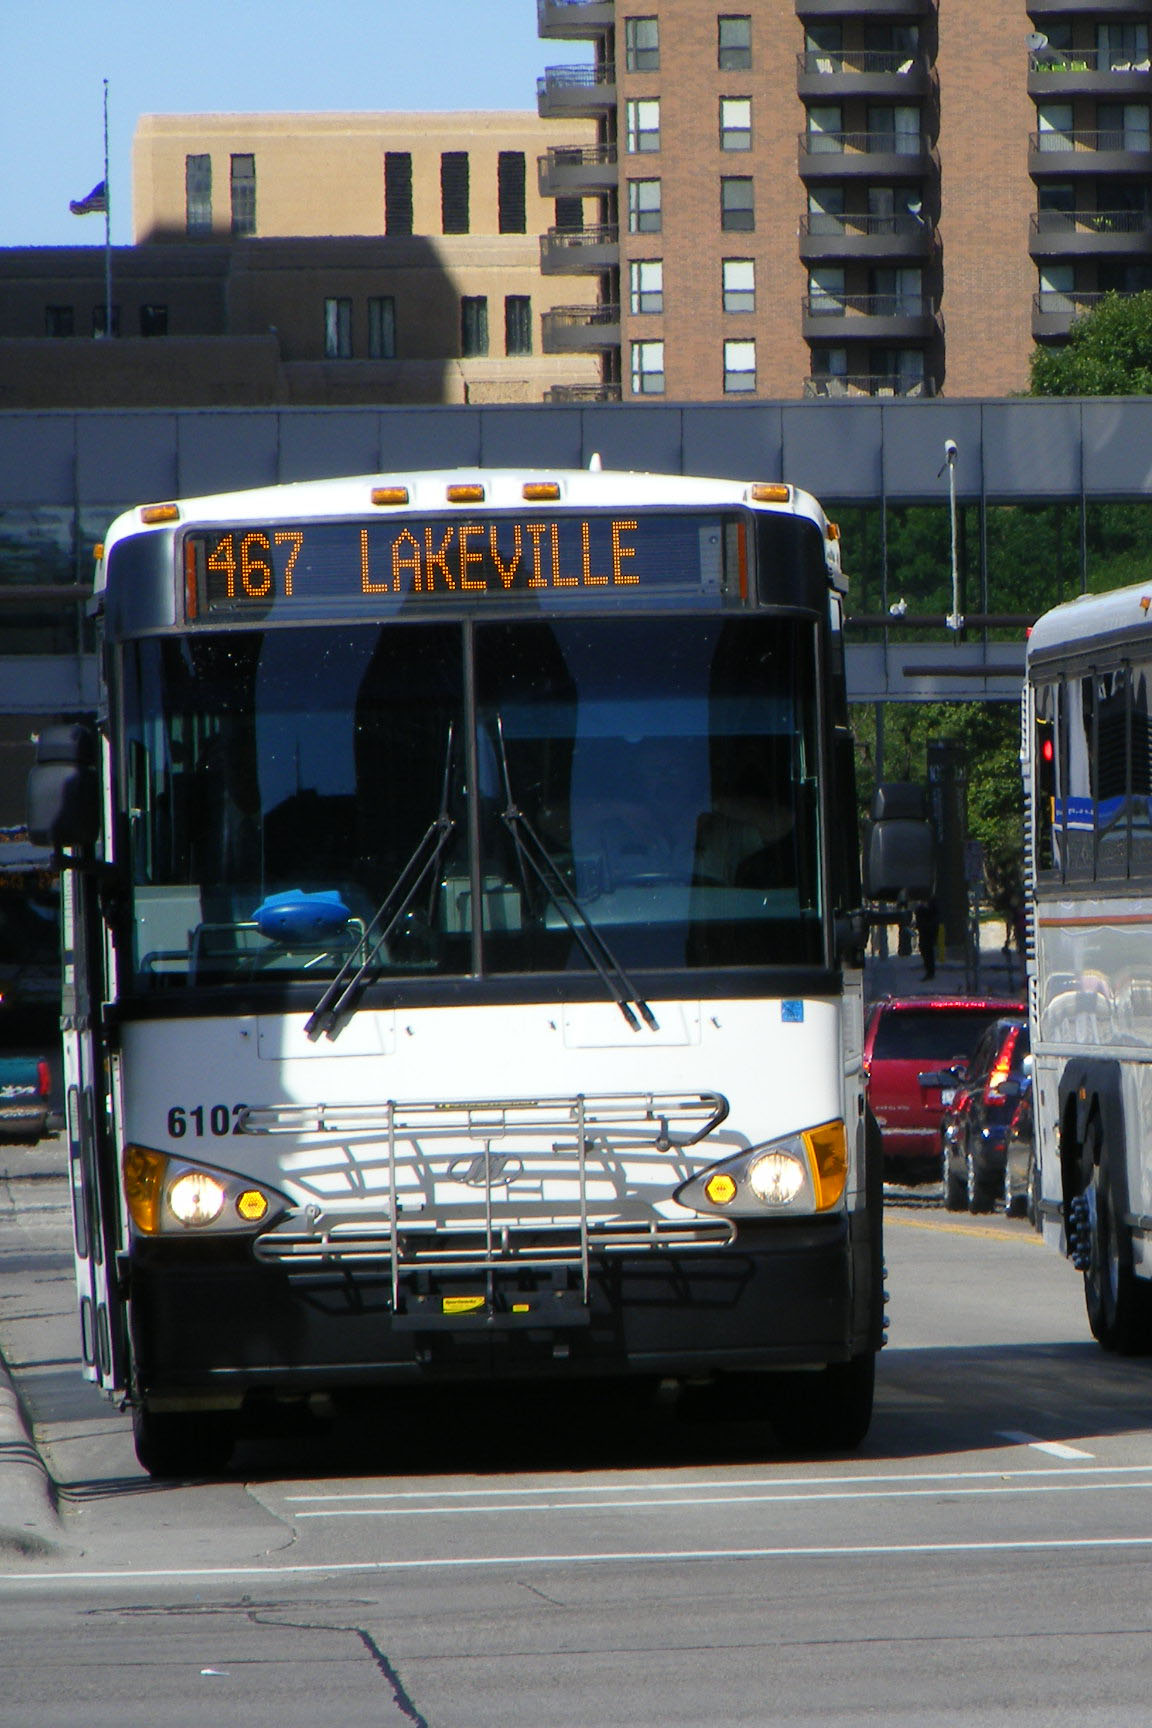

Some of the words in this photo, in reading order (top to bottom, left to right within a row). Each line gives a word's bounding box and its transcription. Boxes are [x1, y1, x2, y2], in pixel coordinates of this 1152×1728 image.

[208, 531, 304, 597] 467
[360, 519, 641, 594] LAKEVILLE
[166, 1103, 251, 1138] 6102
